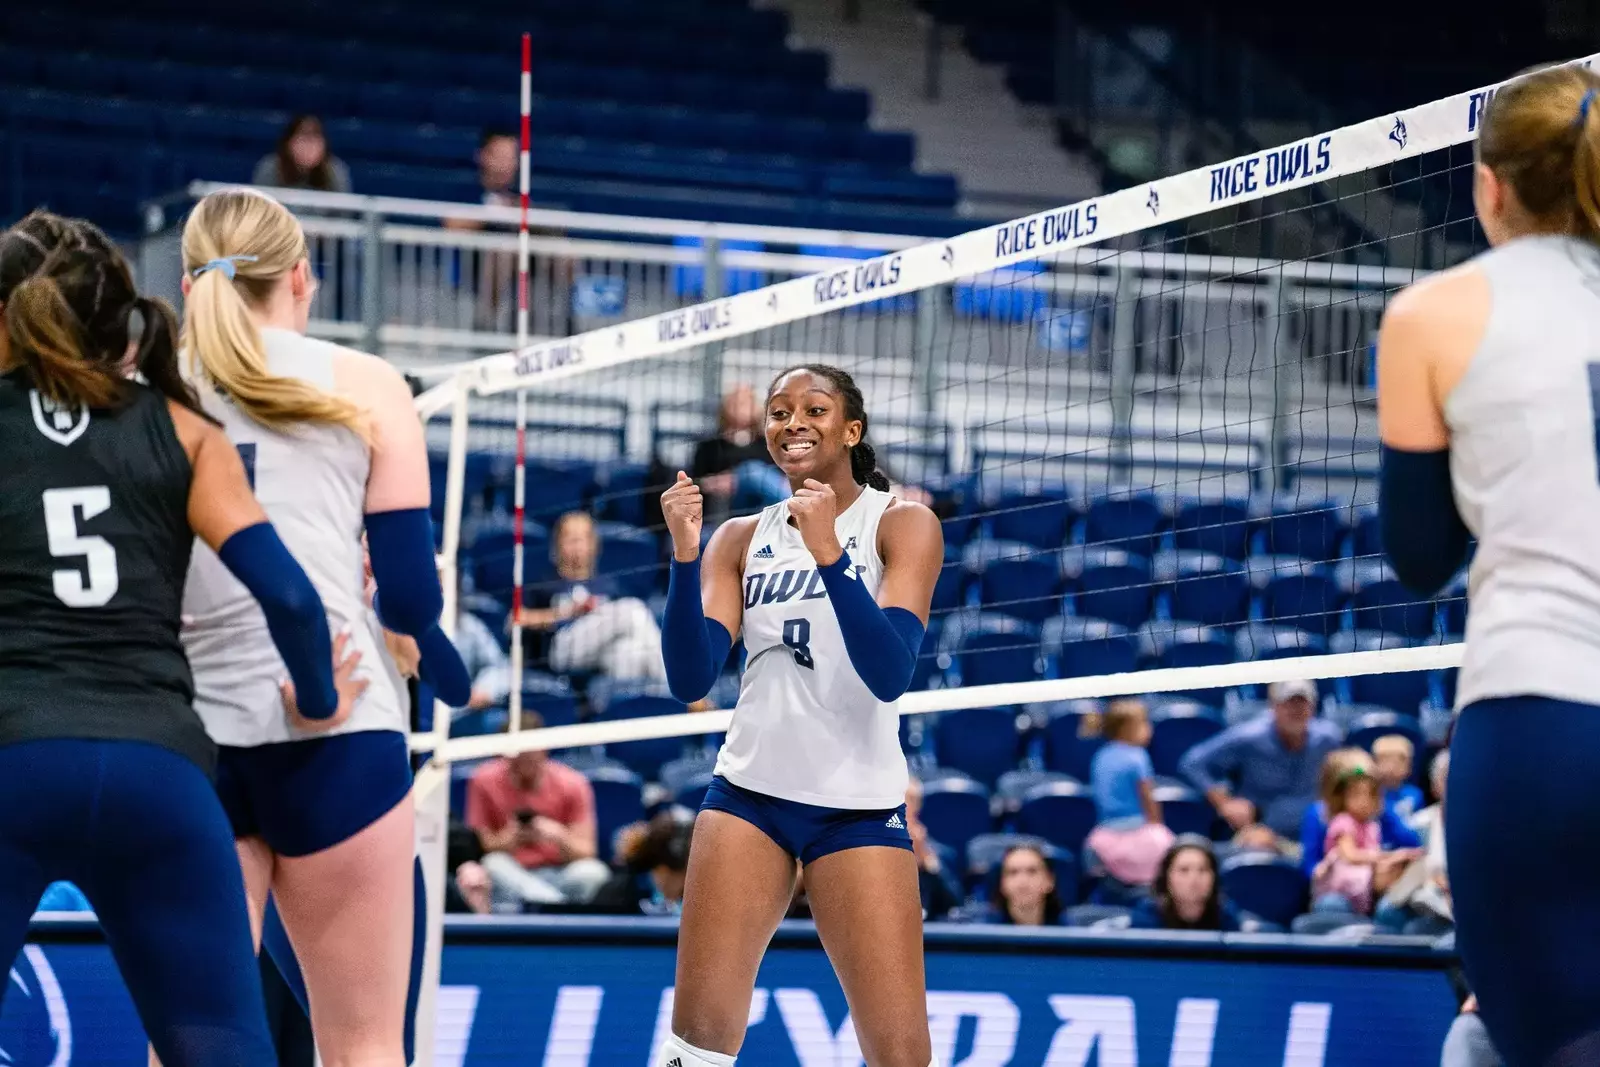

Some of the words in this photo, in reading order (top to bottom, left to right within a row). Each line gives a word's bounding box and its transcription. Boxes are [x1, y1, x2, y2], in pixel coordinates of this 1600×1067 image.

[1210, 158, 1260, 203] RICE
[1265, 137, 1331, 187] OWLS
[996, 219, 1037, 257] RICE
[1043, 204, 1098, 246] OWLS
[814, 271, 849, 305] RICE
[854, 256, 902, 293] OWLS
[43, 485, 119, 608] 5
[745, 564, 867, 611] OWL
[885, 822, 905, 830] adidas
